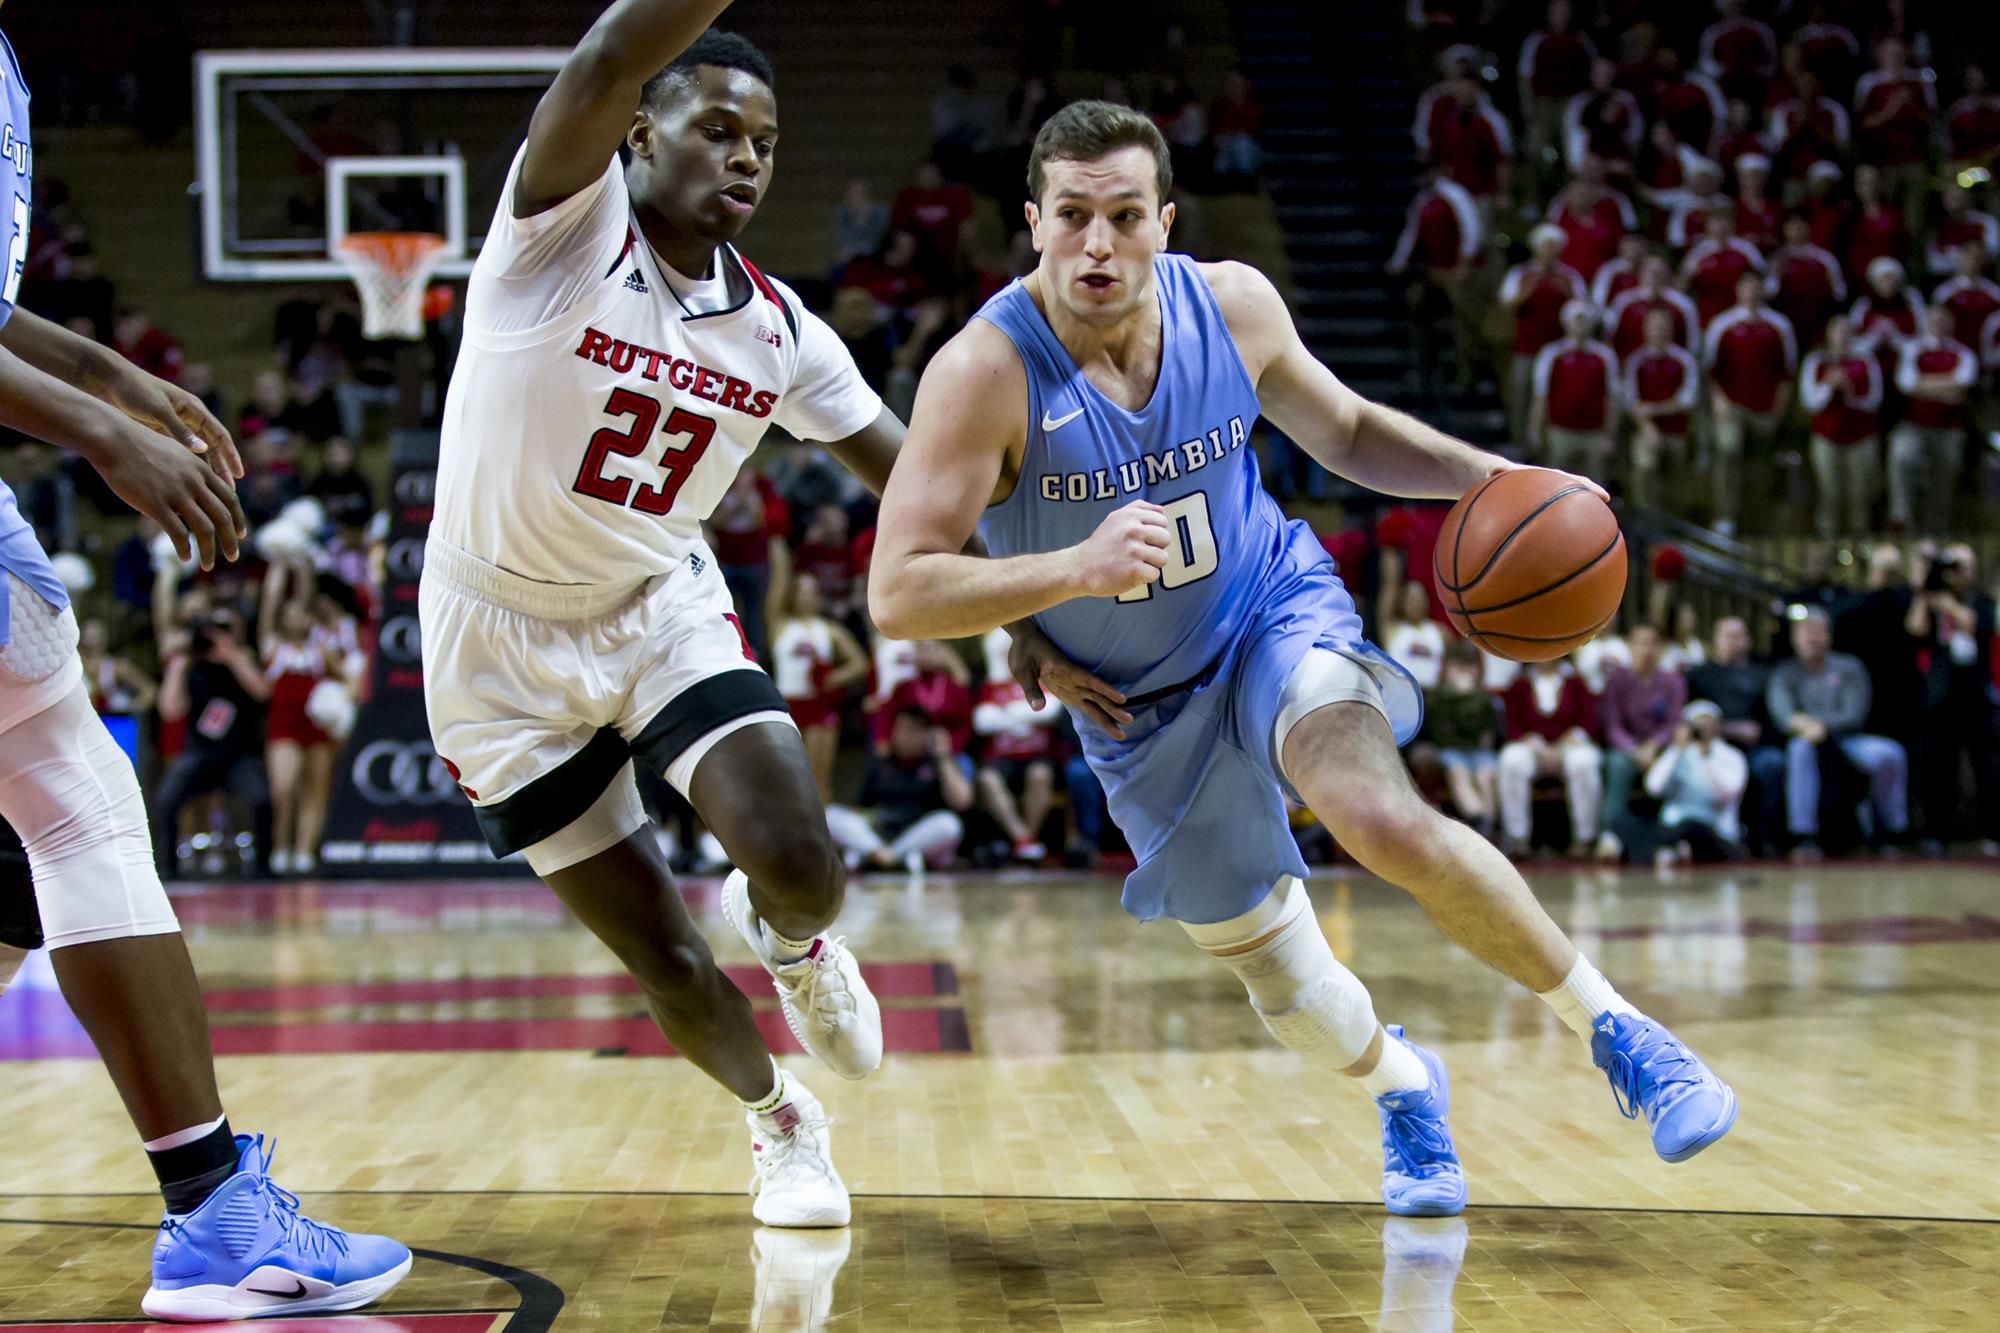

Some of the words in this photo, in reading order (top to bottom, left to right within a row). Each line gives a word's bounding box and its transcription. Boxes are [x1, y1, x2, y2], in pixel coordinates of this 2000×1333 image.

[1, 190, 32, 308] 2
[575, 327, 779, 419] RUTGERS
[572, 386, 717, 516] 23
[1040, 415, 1245, 502] COLUMBIA
[1115, 489, 1220, 604] 0
